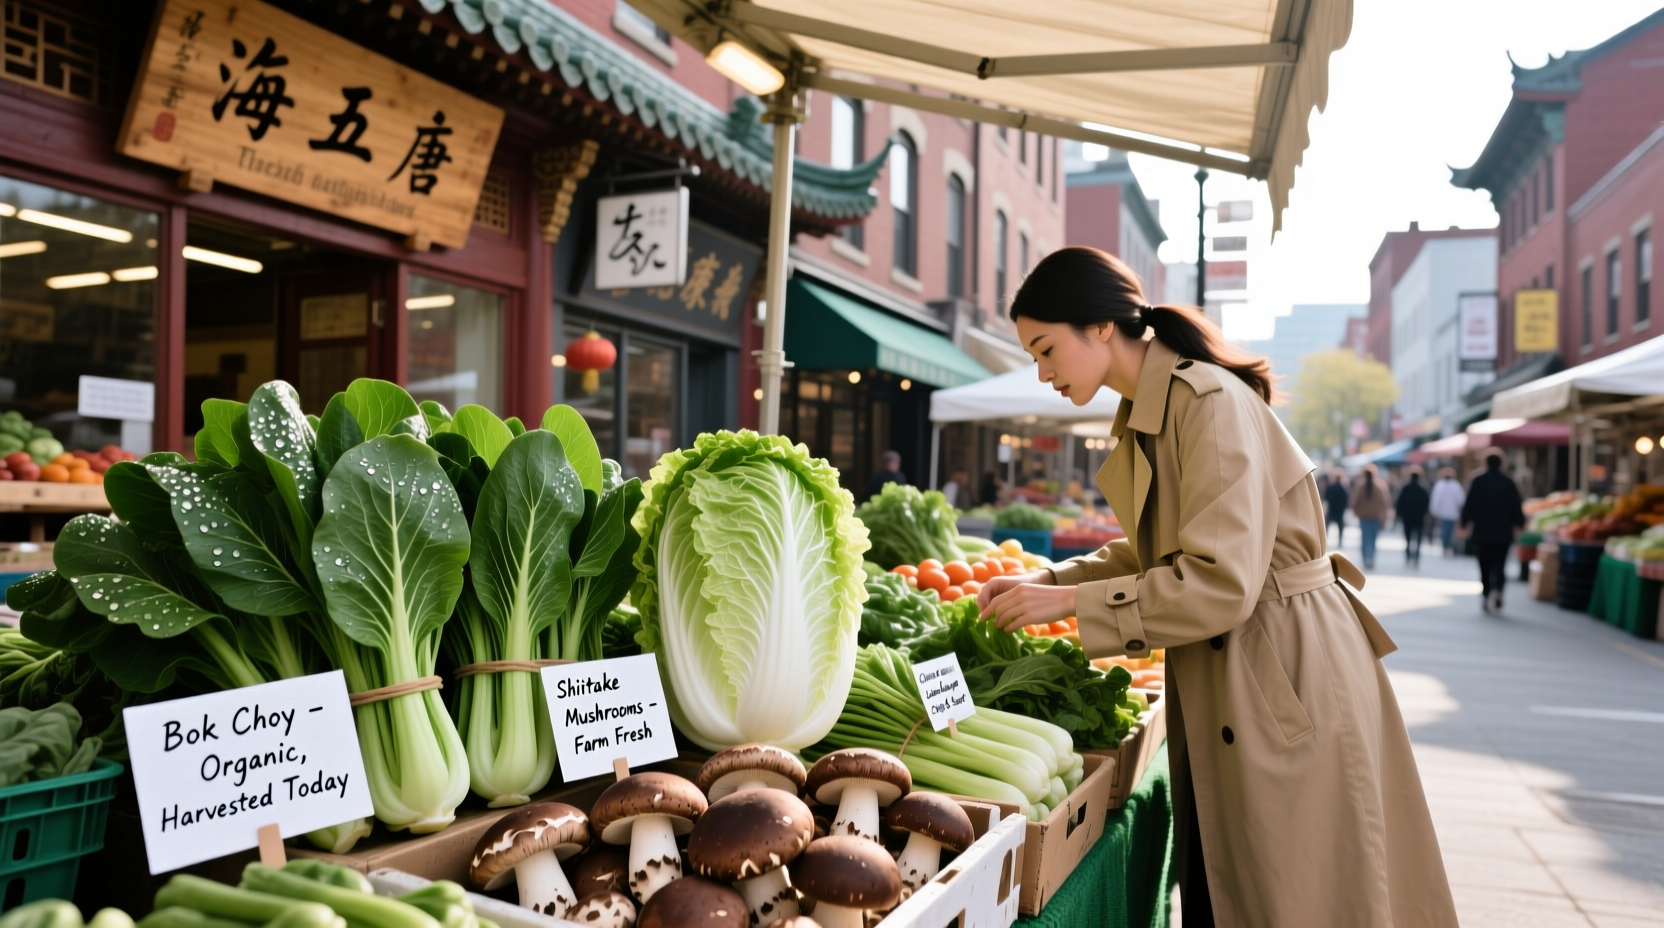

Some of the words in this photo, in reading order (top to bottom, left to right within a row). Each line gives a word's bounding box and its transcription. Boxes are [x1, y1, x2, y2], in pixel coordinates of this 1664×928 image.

[557, 672, 620, 699] Shiitake
[162, 713, 219, 752] Bok
[232, 703, 295, 736] Choy
[565, 702, 643, 727] Mushrooms
[574, 734, 609, 755] Farm
[615, 720, 653, 745] Fresh
[200, 742, 307, 787] Organic,
[161, 782, 273, 833] Harvested
[282, 770, 349, 799] Today
